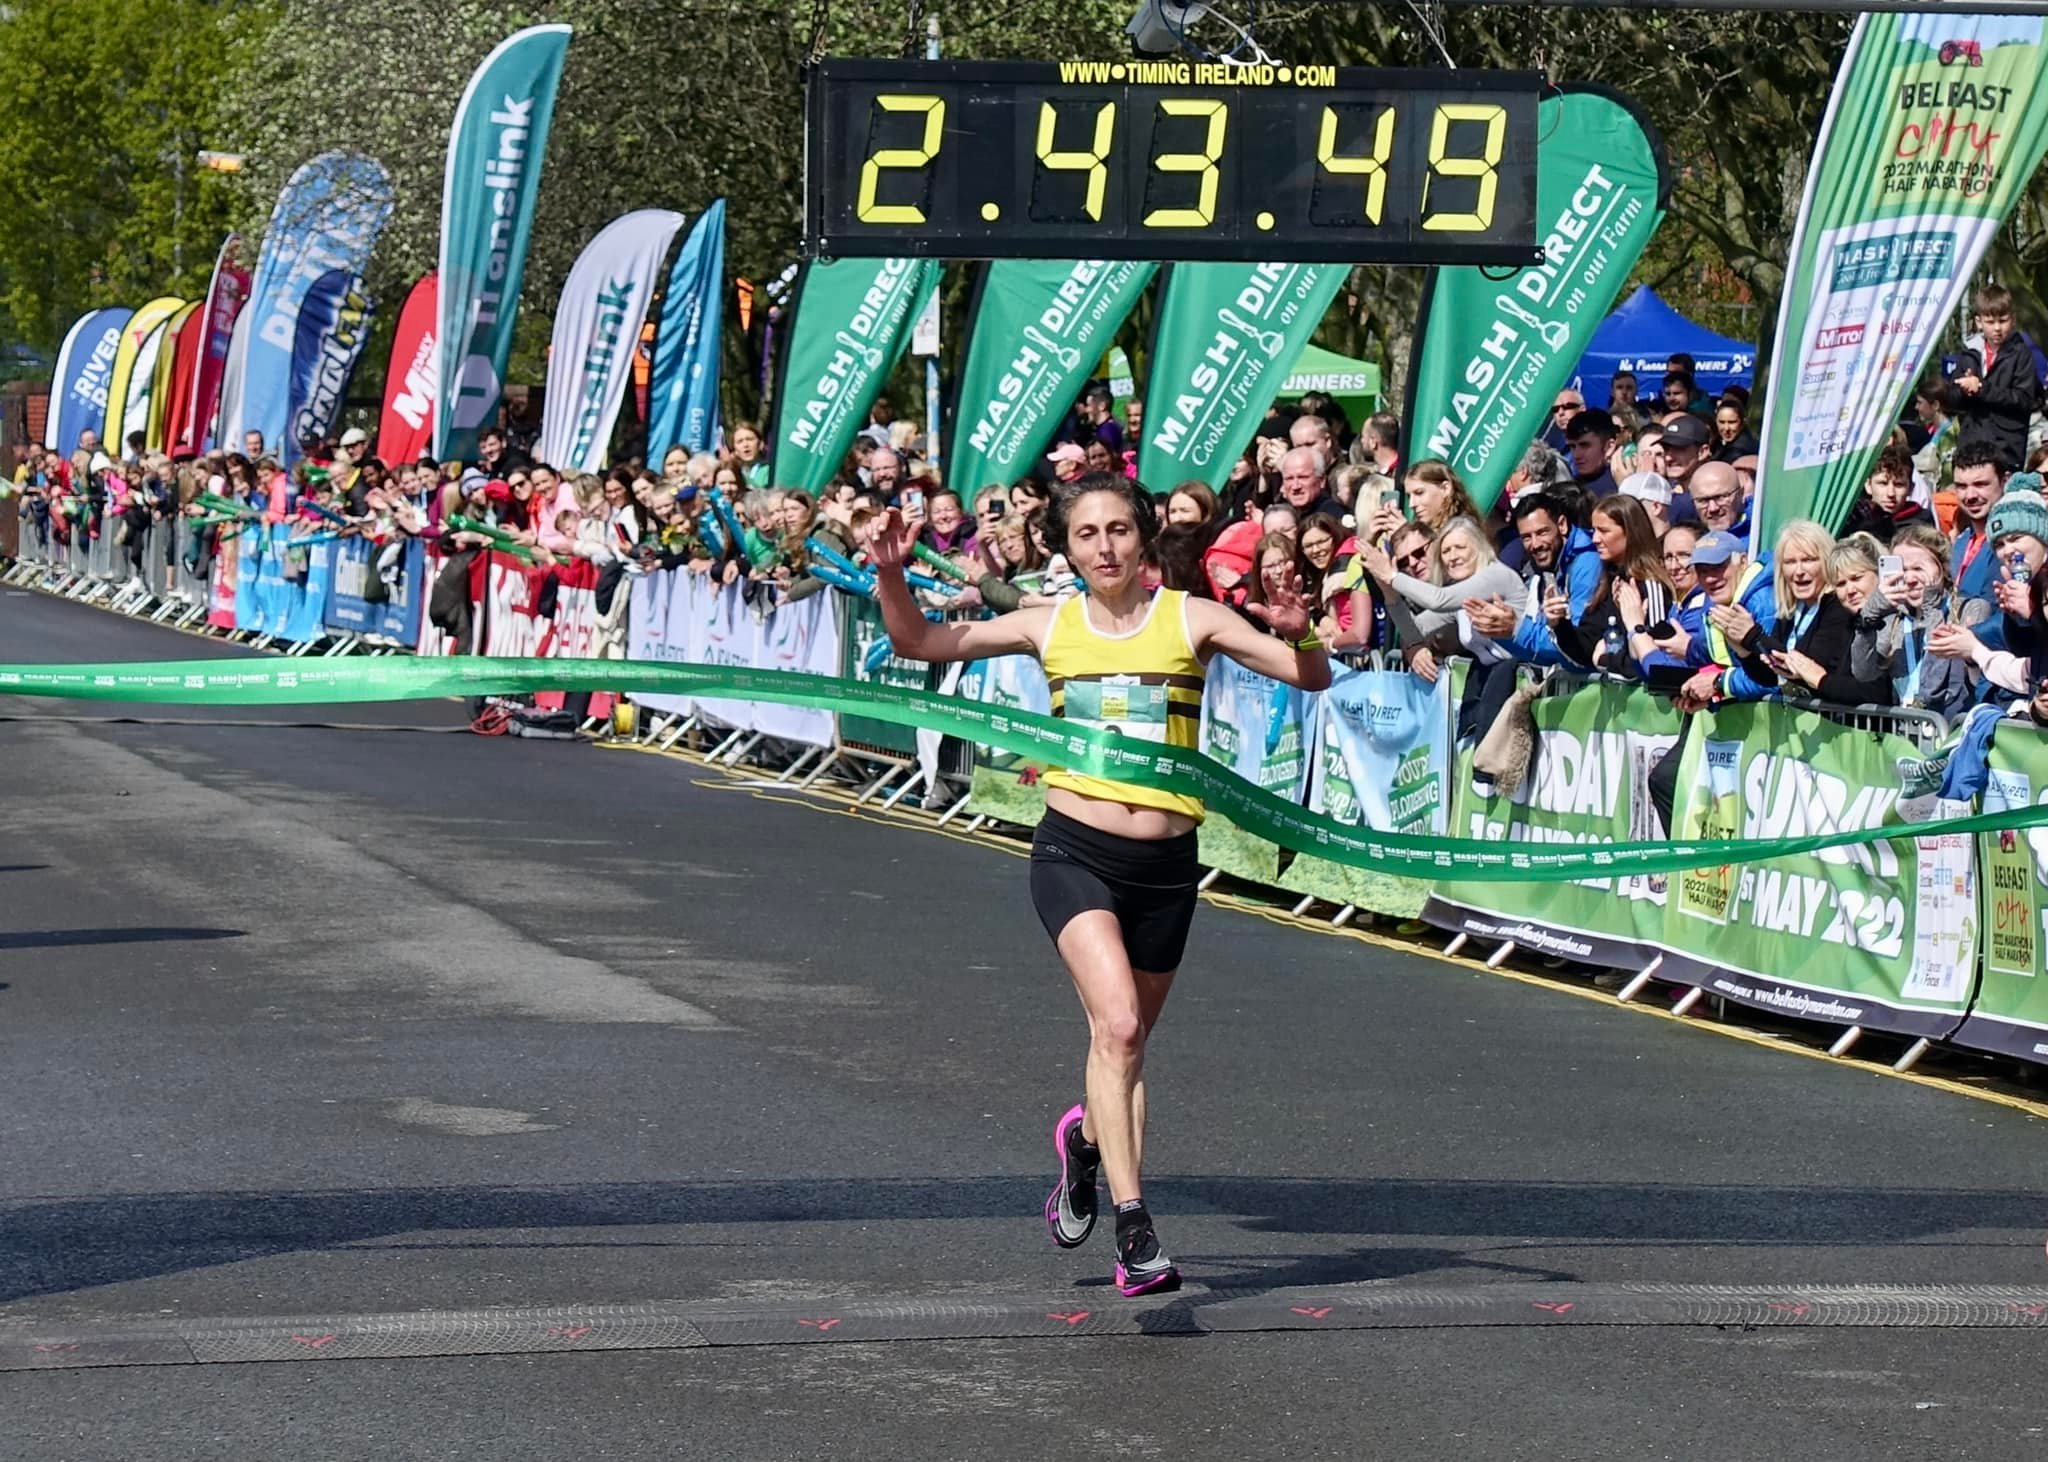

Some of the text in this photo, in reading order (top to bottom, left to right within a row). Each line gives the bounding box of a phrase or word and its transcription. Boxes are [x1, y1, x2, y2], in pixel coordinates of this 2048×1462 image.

[1901, 81, 2013, 113] BELFAST
[879, 325, 895, 344] on
[892, 297, 909, 324] our
[1427, 163, 1614, 461] MASH DIRECT
[1464, 195, 1643, 473] Cooked fresh on our Farm
[73, 327, 121, 399] RIVER
[571, 276, 636, 468] anslink
[788, 258, 906, 449] MASH DIREC
[1191, 266, 1318, 466] Cooked fresh on our
[968, 345, 1042, 453] MASH
[996, 405, 1038, 465] Cooked
[1031, 369, 1063, 416] fresh
[1077, 321, 1095, 343] on
[1091, 292, 1113, 321] our
[1152, 330, 1240, 456] MASH
[1281, 373, 1367, 391] UNNERS
[929, 701, 957, 713] MASH
[959, 707, 986, 721] DIRECT
[1010, 720, 1038, 734] MASH
[1039, 728, 1066, 743] DIRECT
[1369, 703, 1403, 721] DIRECT
[1121, 750, 1152, 764] DIRECT
[1384, 845, 1407, 857] MASH
[1408, 849, 1433, 859] DIRECT
[1453, 853, 1506, 864] MASH DIRECT
[1531, 854, 1557, 864] MASH
[1753, 866, 1829, 937] MAY
[1993, 864, 2028, 892] BELFAST
